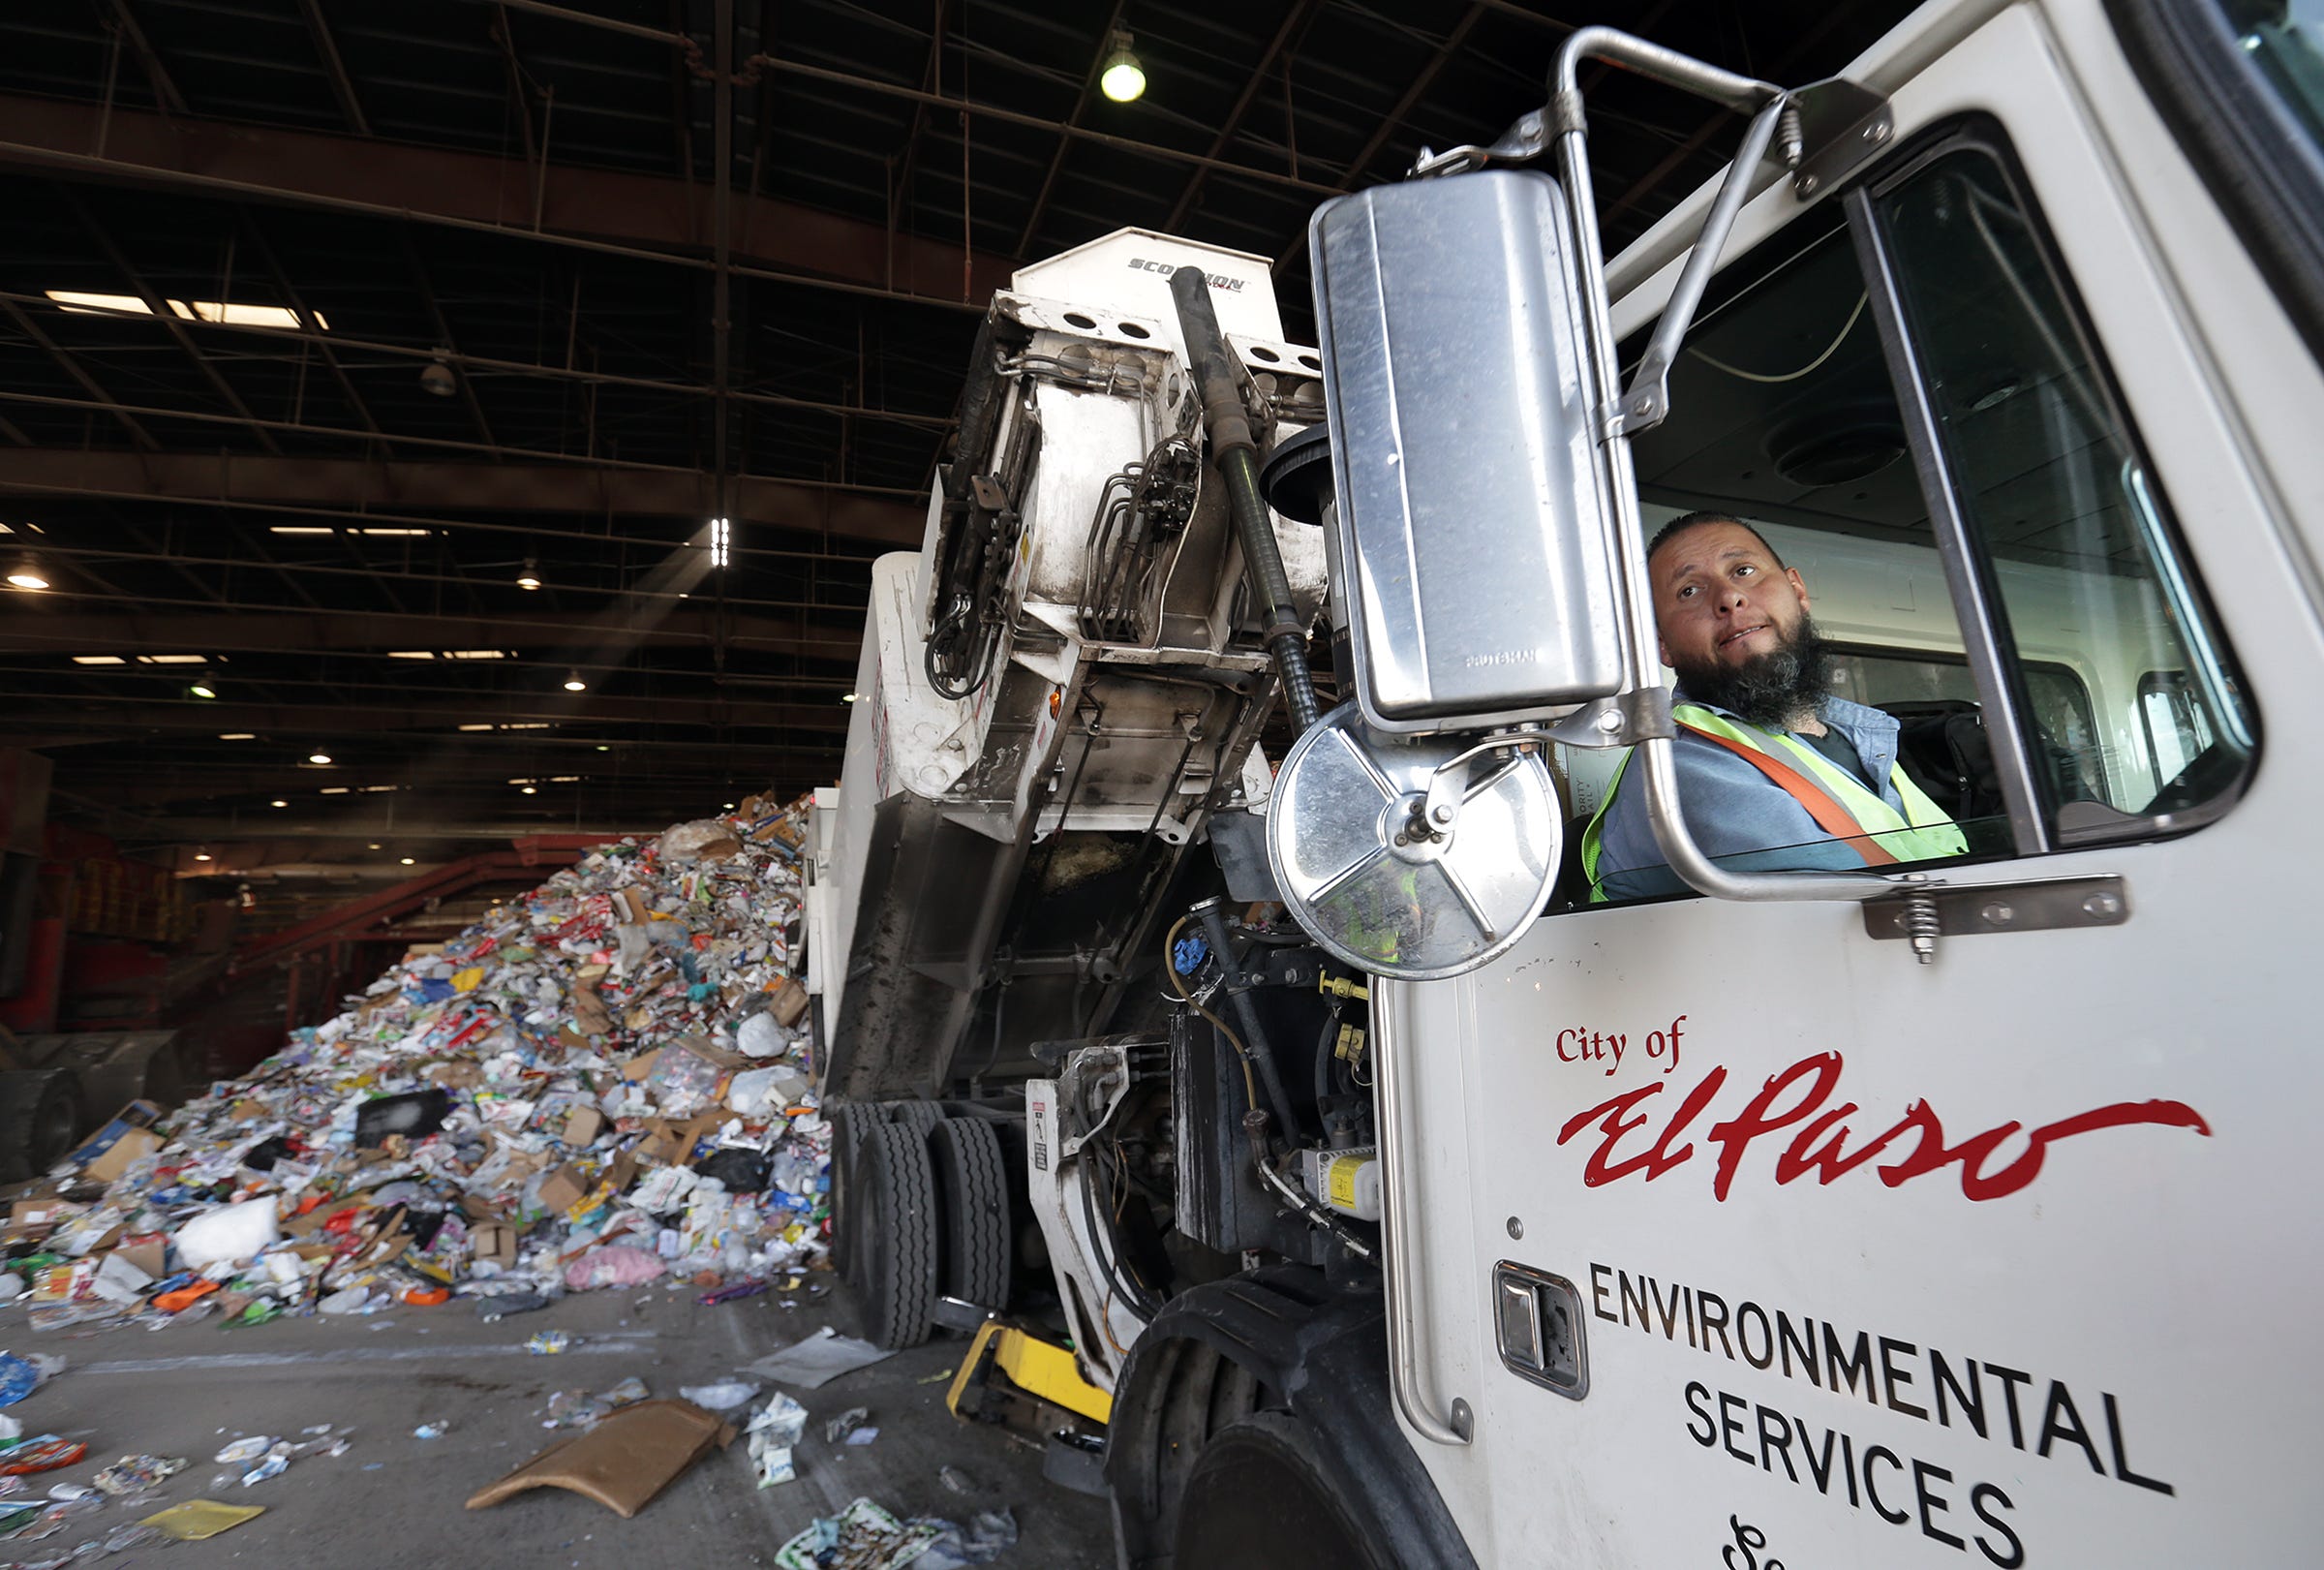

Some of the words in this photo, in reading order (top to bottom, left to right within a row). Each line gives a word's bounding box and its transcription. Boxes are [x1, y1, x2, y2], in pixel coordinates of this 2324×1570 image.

[1127, 258, 1245, 290] SCOION
[1577, 779, 1587, 814] ORITY
[1556, 1025, 1628, 1076] City
[1645, 1014, 1687, 1073] of
[1557, 1065, 1728, 1188] El
[1708, 1051, 2213, 1202] Paso
[1590, 1263, 2175, 1497] ENVIRONMENTAL
[1684, 1381, 2025, 1570] SERVICES
